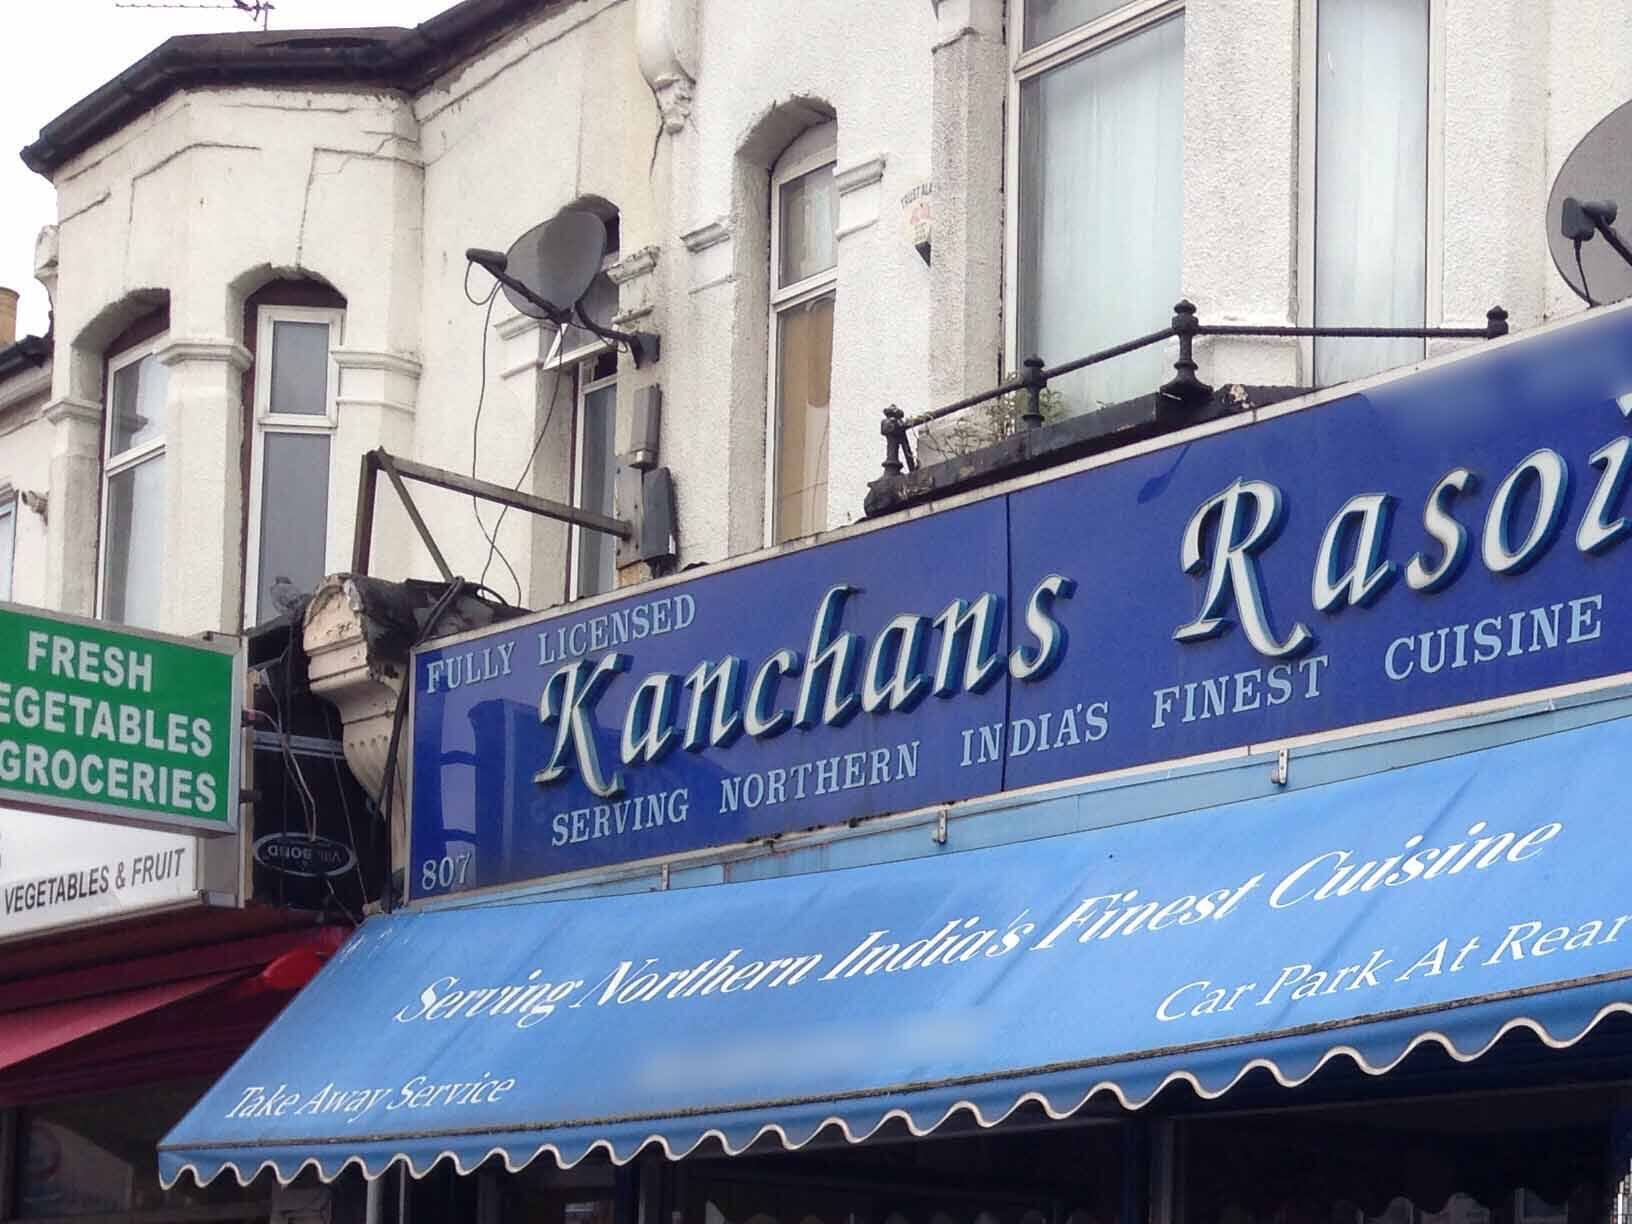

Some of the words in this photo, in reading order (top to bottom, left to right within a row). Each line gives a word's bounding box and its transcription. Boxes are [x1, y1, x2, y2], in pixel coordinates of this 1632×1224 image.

[27, 630, 154, 693] FRESH
[425, 640, 517, 695] FULLY
[537, 593, 697, 665] LICENSED
[0, 682, 213, 758] EGETABLES
[533, 573, 1078, 799] Kanchans
[551, 788, 691, 848] SERVING
[718, 741, 920, 814] NORTHERN
[960, 701, 1111, 767] INDIA'S
[1152, 655, 1330, 729] FINEST
[1385, 594, 1602, 682] CUISINE
[0, 739, 217, 812] GROCERIES
[5, 865, 110, 915] VEGETABLES
[115, 864, 127, 889] &
[131, 847, 186, 886] FRUIT
[421, 851, 472, 890] 807
[395, 968, 582, 1029] Serving
[571, 948, 816, 1010] Northern
[817, 908, 1034, 983] India's
[1031, 872, 1266, 952] Finest
[1271, 818, 1564, 910] Cuisine
[1155, 980, 1239, 1023] Car
[1257, 947, 1398, 1005] Park
[1397, 934, 1484, 981] At
[225, 1085, 299, 1119] Take
[295, 1080, 386, 1123] Away
[386, 1069, 517, 1111] Service
